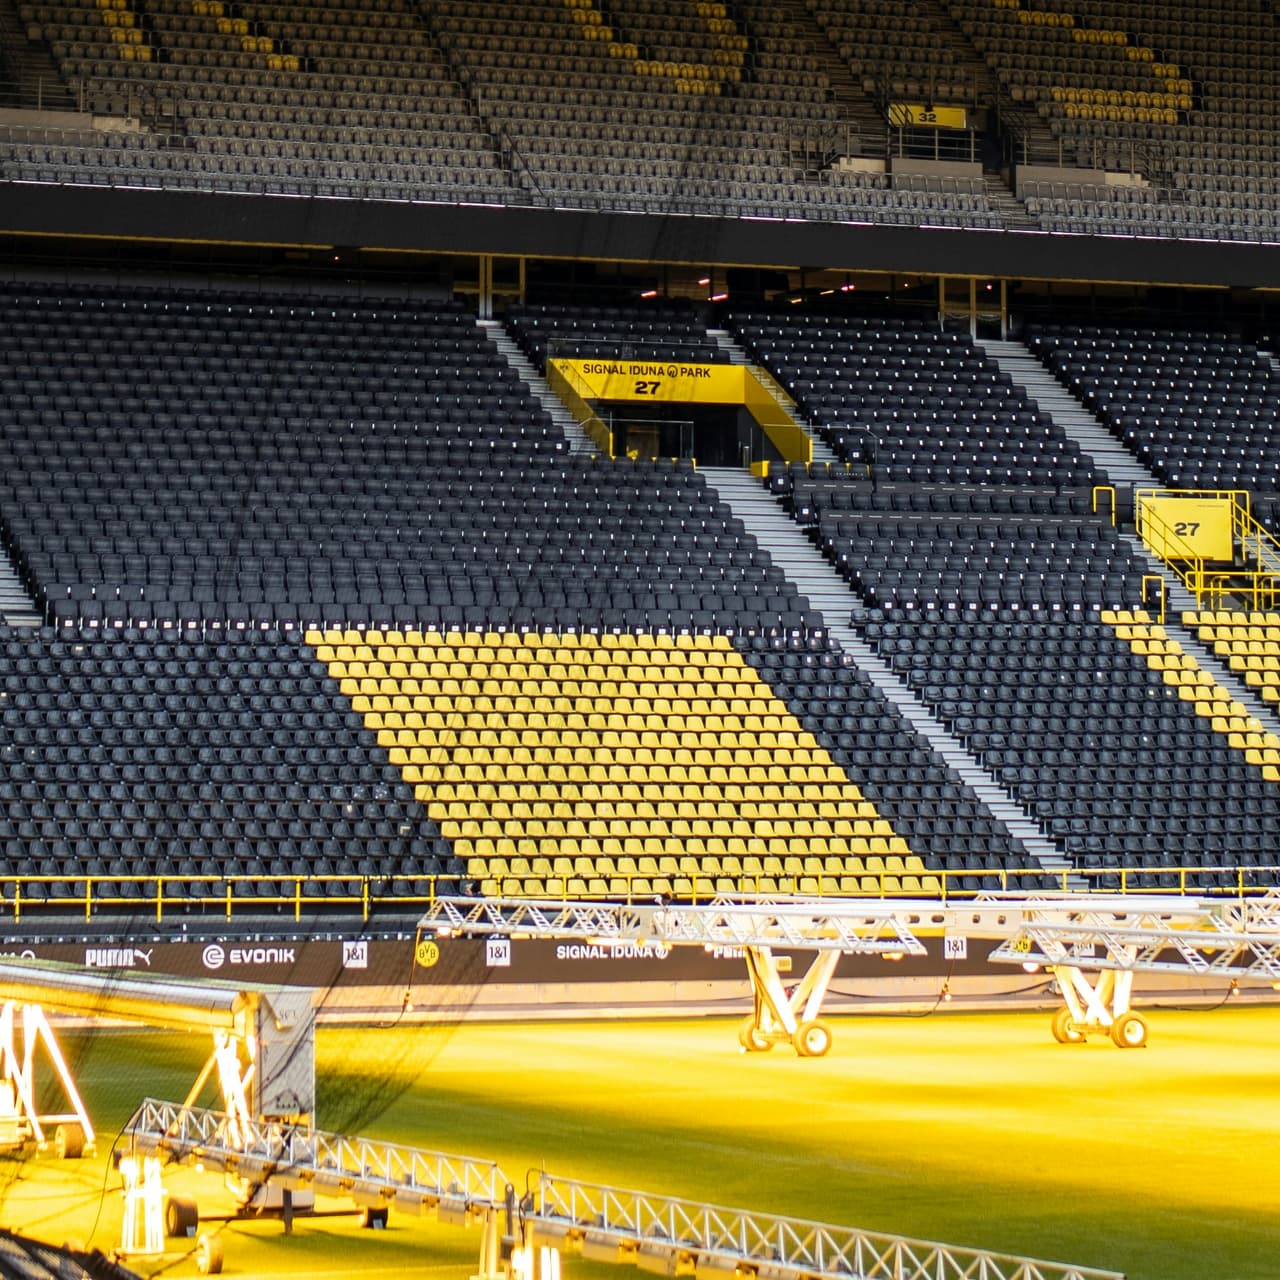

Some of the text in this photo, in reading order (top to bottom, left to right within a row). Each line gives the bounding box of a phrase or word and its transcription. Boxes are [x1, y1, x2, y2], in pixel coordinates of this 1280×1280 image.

[919, 113, 937, 123] 32
[583, 363, 711, 378] SIGNAL IDUNA PARK
[634, 381, 661, 395] 27
[1174, 522, 1201, 537] 27
[419, 944, 436, 959] BVB
[489, 946, 507, 959] 1&1
[556, 945, 654, 959] SIGNAL IDUNA
[947, 939, 964, 953] 1&1
[85, 949, 134, 967] PUMA
[229, 948, 295, 963] EVONIK
[346, 947, 364, 961] 1&1
